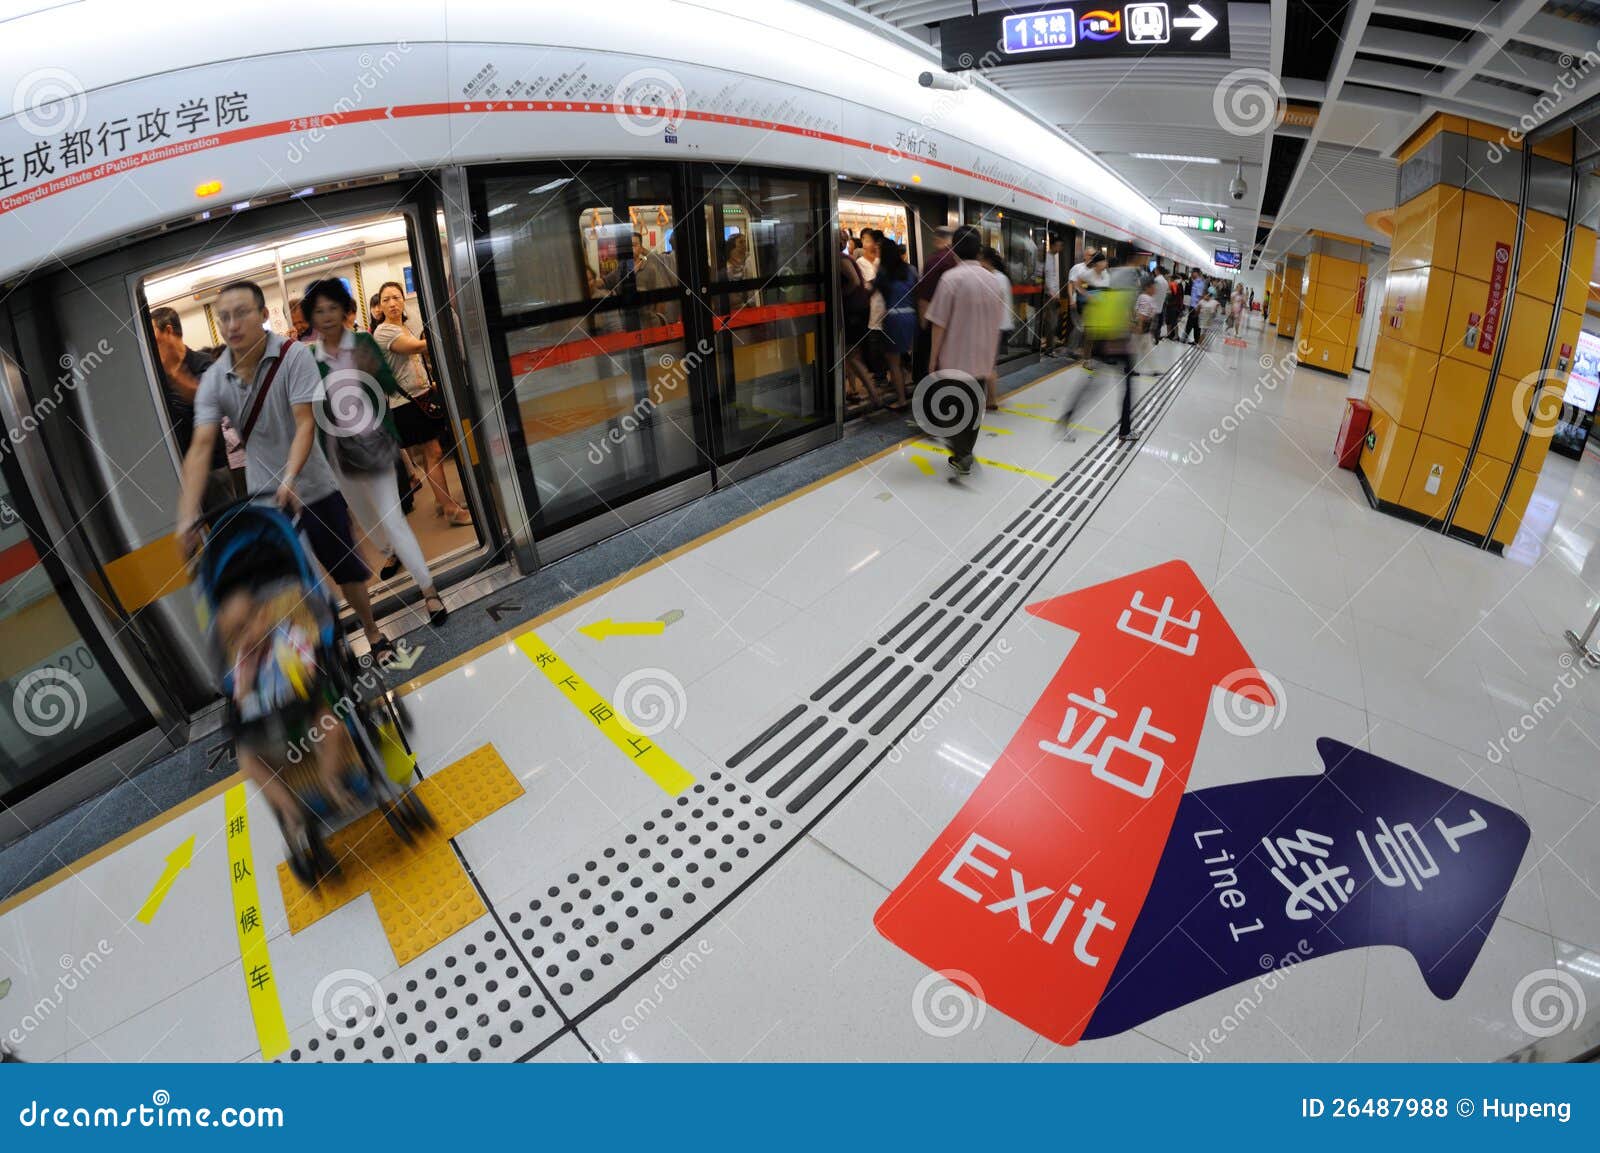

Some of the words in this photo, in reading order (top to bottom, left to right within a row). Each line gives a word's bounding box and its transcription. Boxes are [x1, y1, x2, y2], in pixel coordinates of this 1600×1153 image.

[1034, 32, 1068, 46] Line
[1, 187, 48, 210] Chengdu
[49, 171, 93, 192] Institute
[94, 165, 105, 177] of
[106, 156, 140, 174] Public
[141, 136, 220, 163] Administration
[535, 652, 652, 758] 先下后上
[1038, 589, 1202, 800] 出站
[229, 815, 271, 991] 排队候车
[938, 832, 1117, 967] Exit
[1193, 828, 1247, 909] Line
[1229, 918, 1265, 943] 1
[1261, 808, 1488, 921] 1号线
